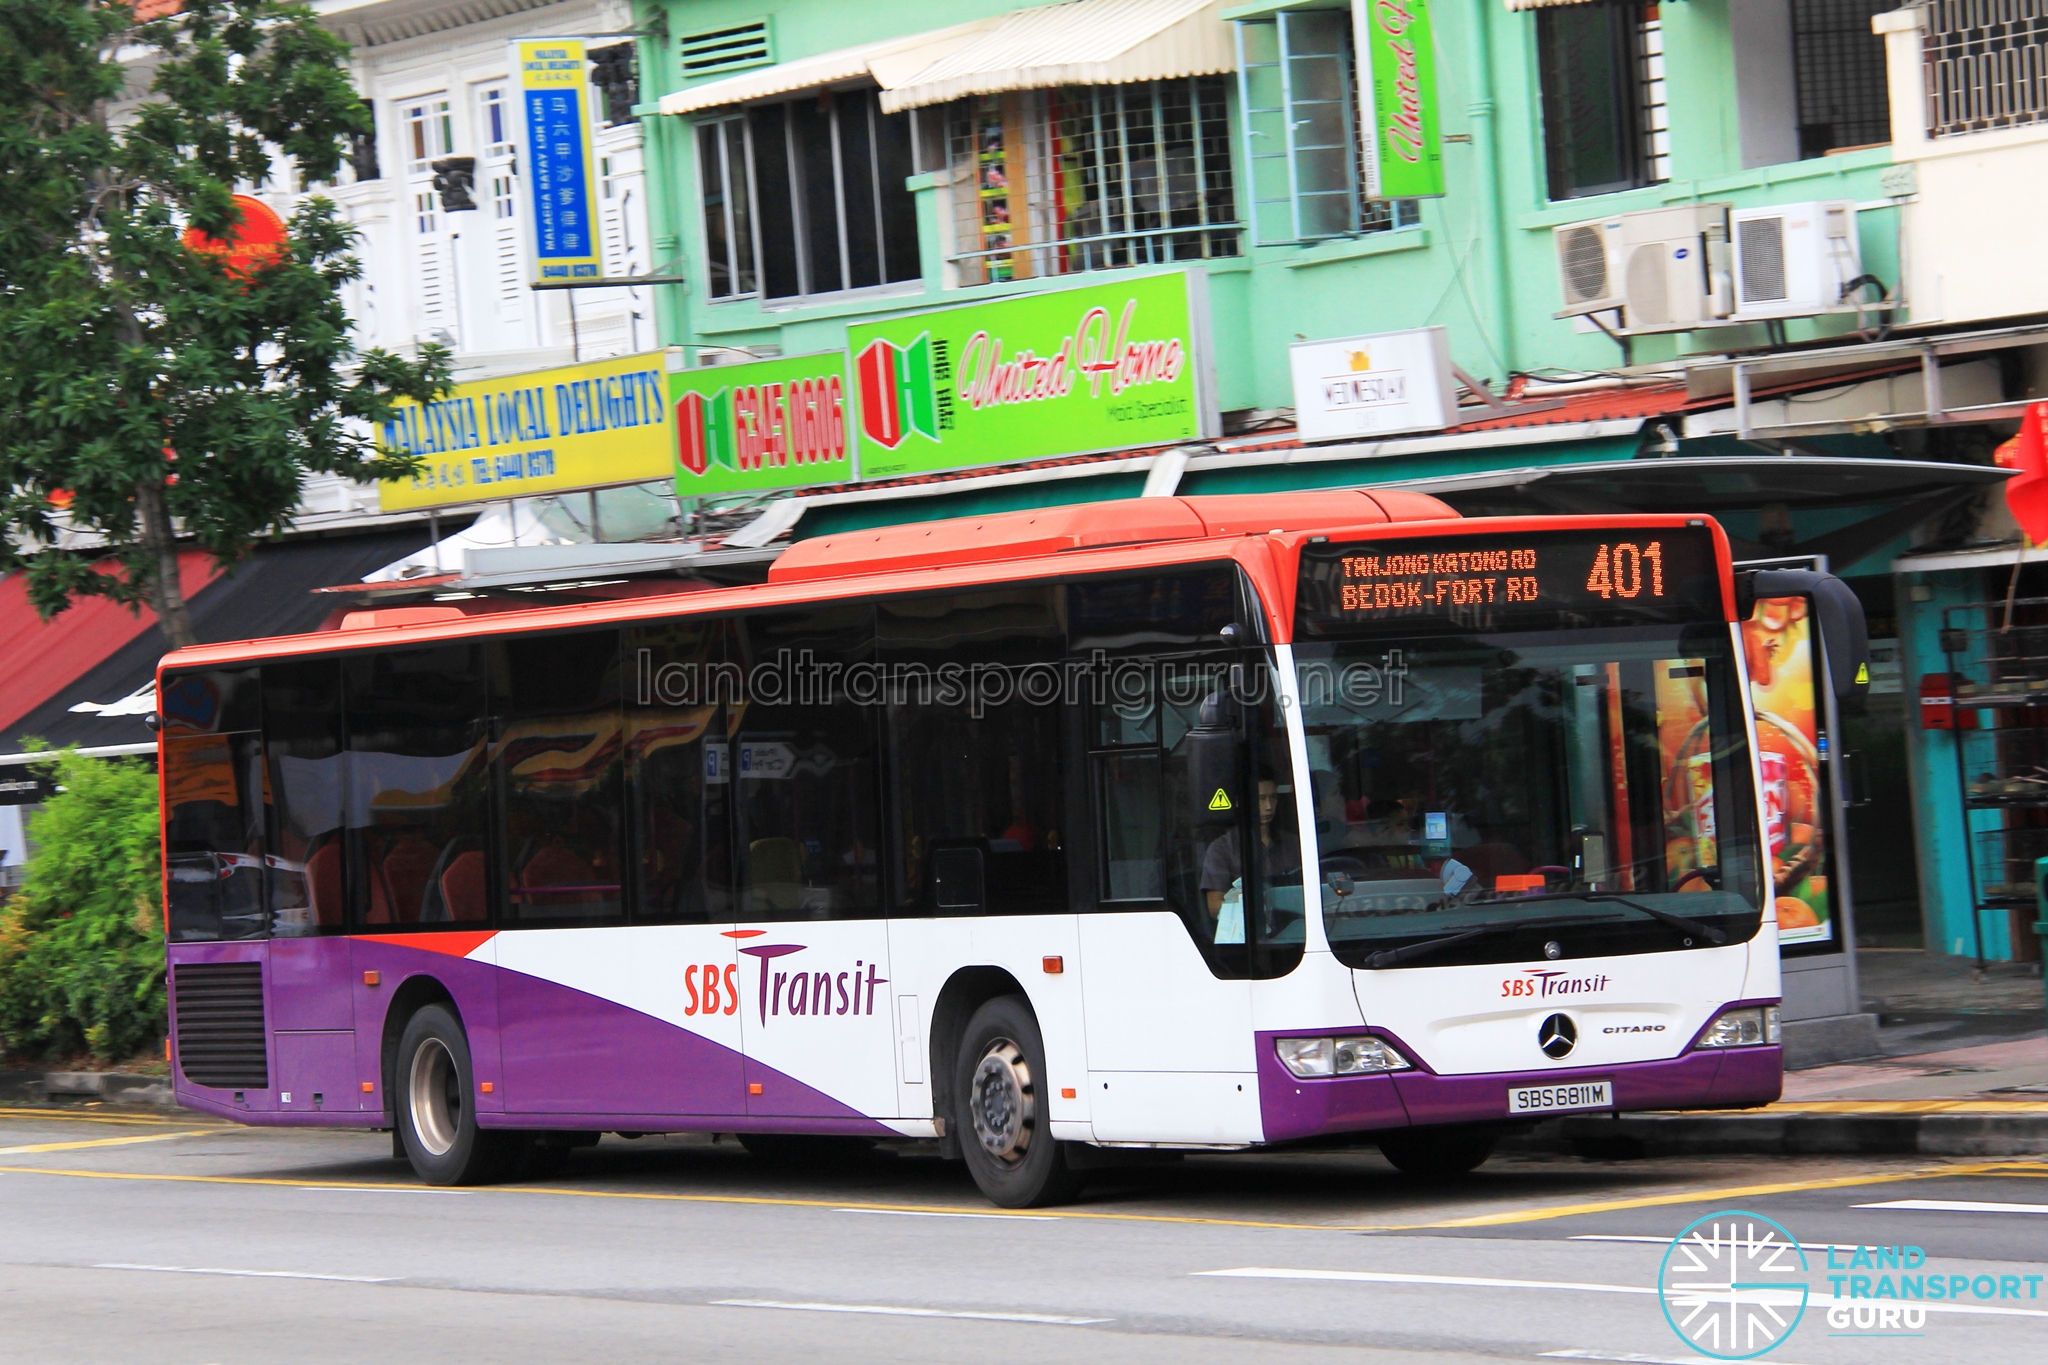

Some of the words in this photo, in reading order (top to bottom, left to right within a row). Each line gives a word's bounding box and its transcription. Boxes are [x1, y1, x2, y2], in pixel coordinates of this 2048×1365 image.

[957, 330, 1075, 409] United
[1075, 298, 1185, 397] Home
[483, 386, 551, 445] LOCAL
[555, 369, 665, 436] DELIGHTS
[734, 382, 788, 472] 6345
[788, 374, 845, 466] 0606
[1342, 554, 1429, 578] TANJONG
[1432, 550, 1508, 575] KATONG
[1510, 549, 1537, 570] RD
[1587, 541, 1664, 599] 401
[1342, 577, 1496, 611] BEDOK-FORT
[1507, 576, 1538, 602] RD
[684, 963, 738, 1016] SBS
[738, 944, 890, 1029] Transit
[1501, 978, 1534, 998] SBS
[1531, 970, 1613, 999] Transit
[1602, 1024, 1666, 1035] CITARO
[1518, 1084, 1604, 1109] SBS6811M
